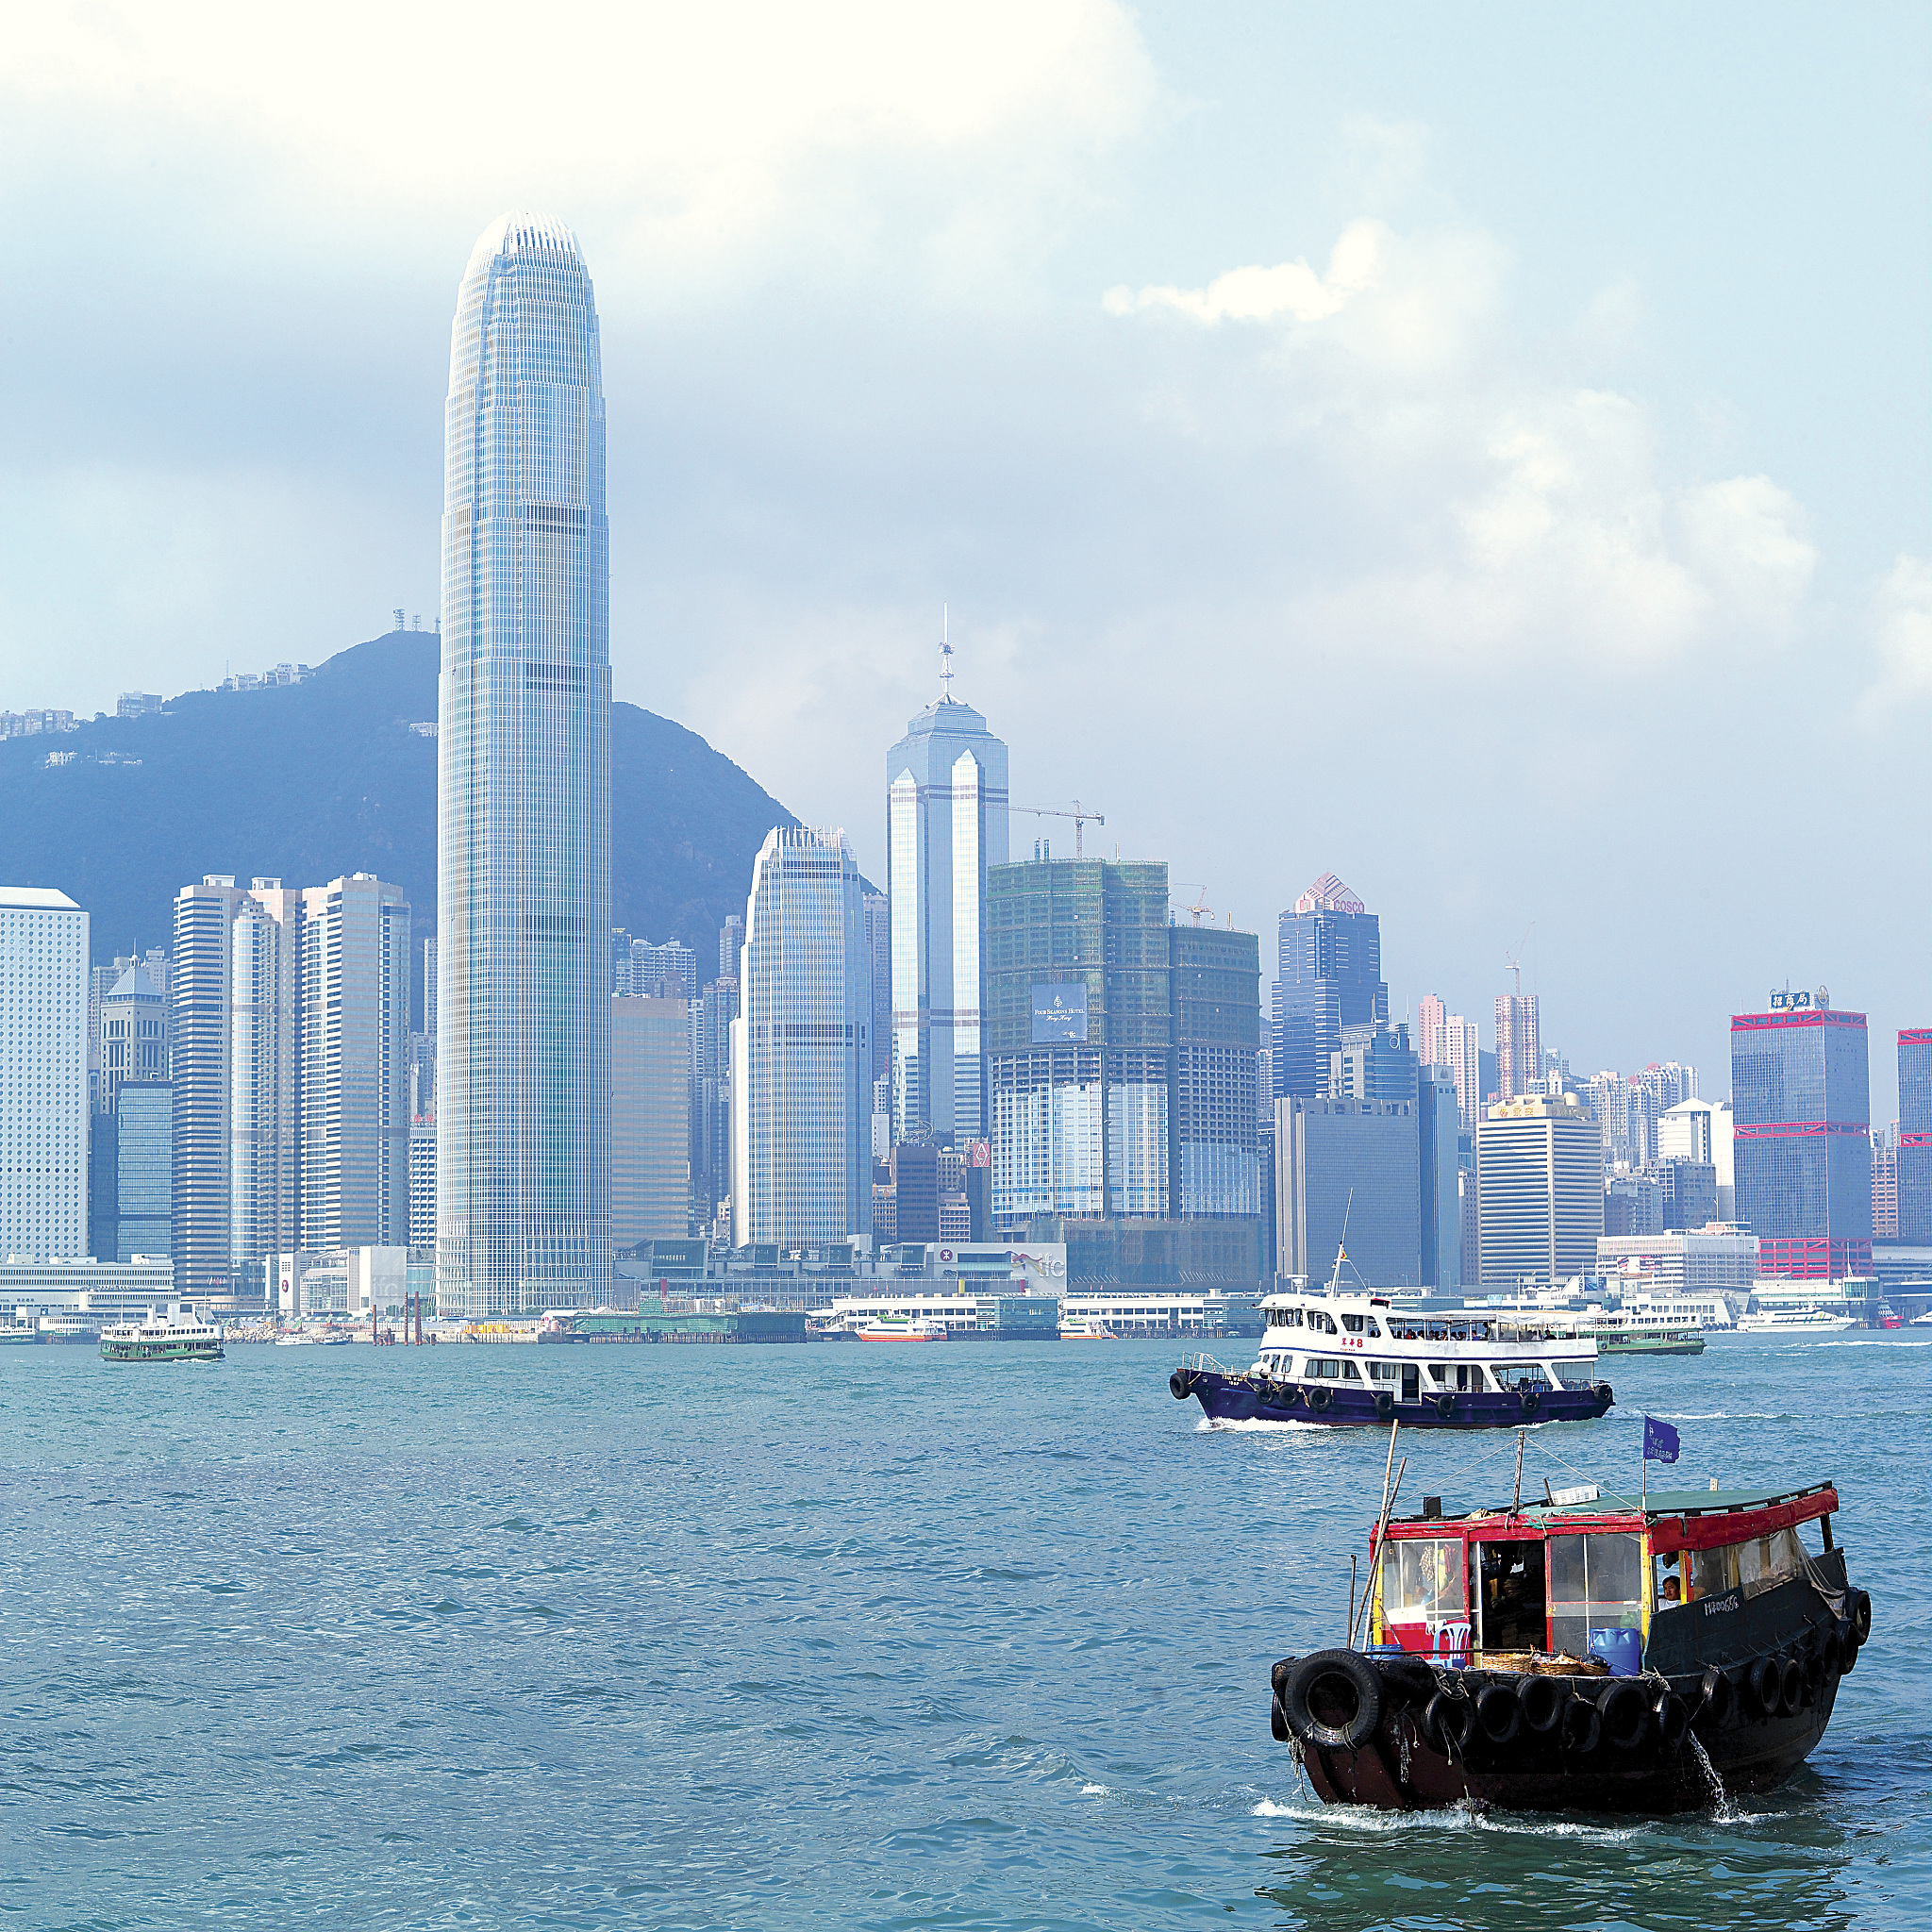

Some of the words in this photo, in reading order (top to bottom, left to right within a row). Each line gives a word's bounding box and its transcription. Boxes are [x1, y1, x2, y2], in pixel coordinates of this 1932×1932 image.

[1333, 899, 1364, 914] COSCO
[1773, 993, 1808, 1010] 招商局
[1039, 1253, 1065, 1278] ifc
